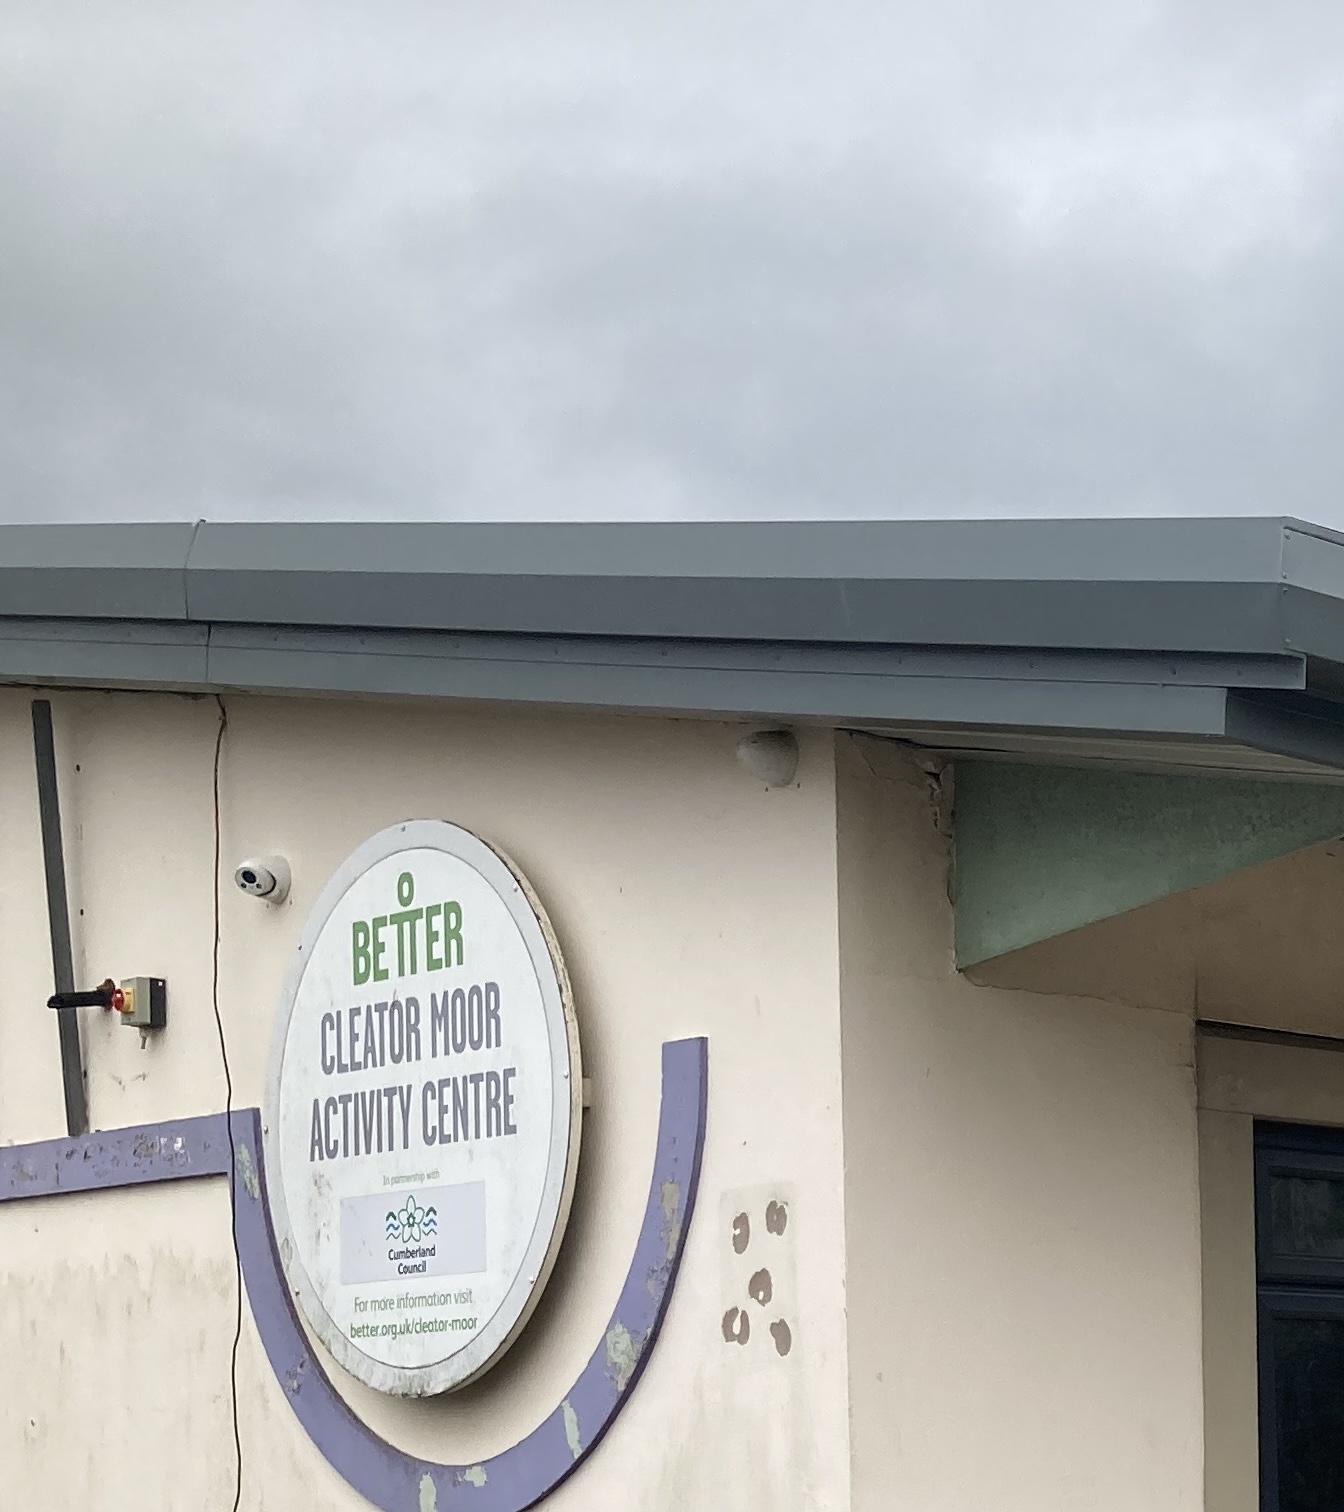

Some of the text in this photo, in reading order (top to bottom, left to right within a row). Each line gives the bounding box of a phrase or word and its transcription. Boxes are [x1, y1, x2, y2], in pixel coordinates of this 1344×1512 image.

[352, 901, 463, 986] BETTER
[321, 982, 501, 1075] CLEATOR MOOR
[310, 1067, 517, 1162] ACTIVITY CENTRE
[391, 1173, 425, 1187] partnership
[426, 1170, 440, 1180] with
[388, 1244, 436, 1260] Cumberland
[398, 1260, 427, 1275] Council
[354, 1288, 473, 1313] For more information visit
[350, 1317, 478, 1341] better.org.uk/cleator-moor
